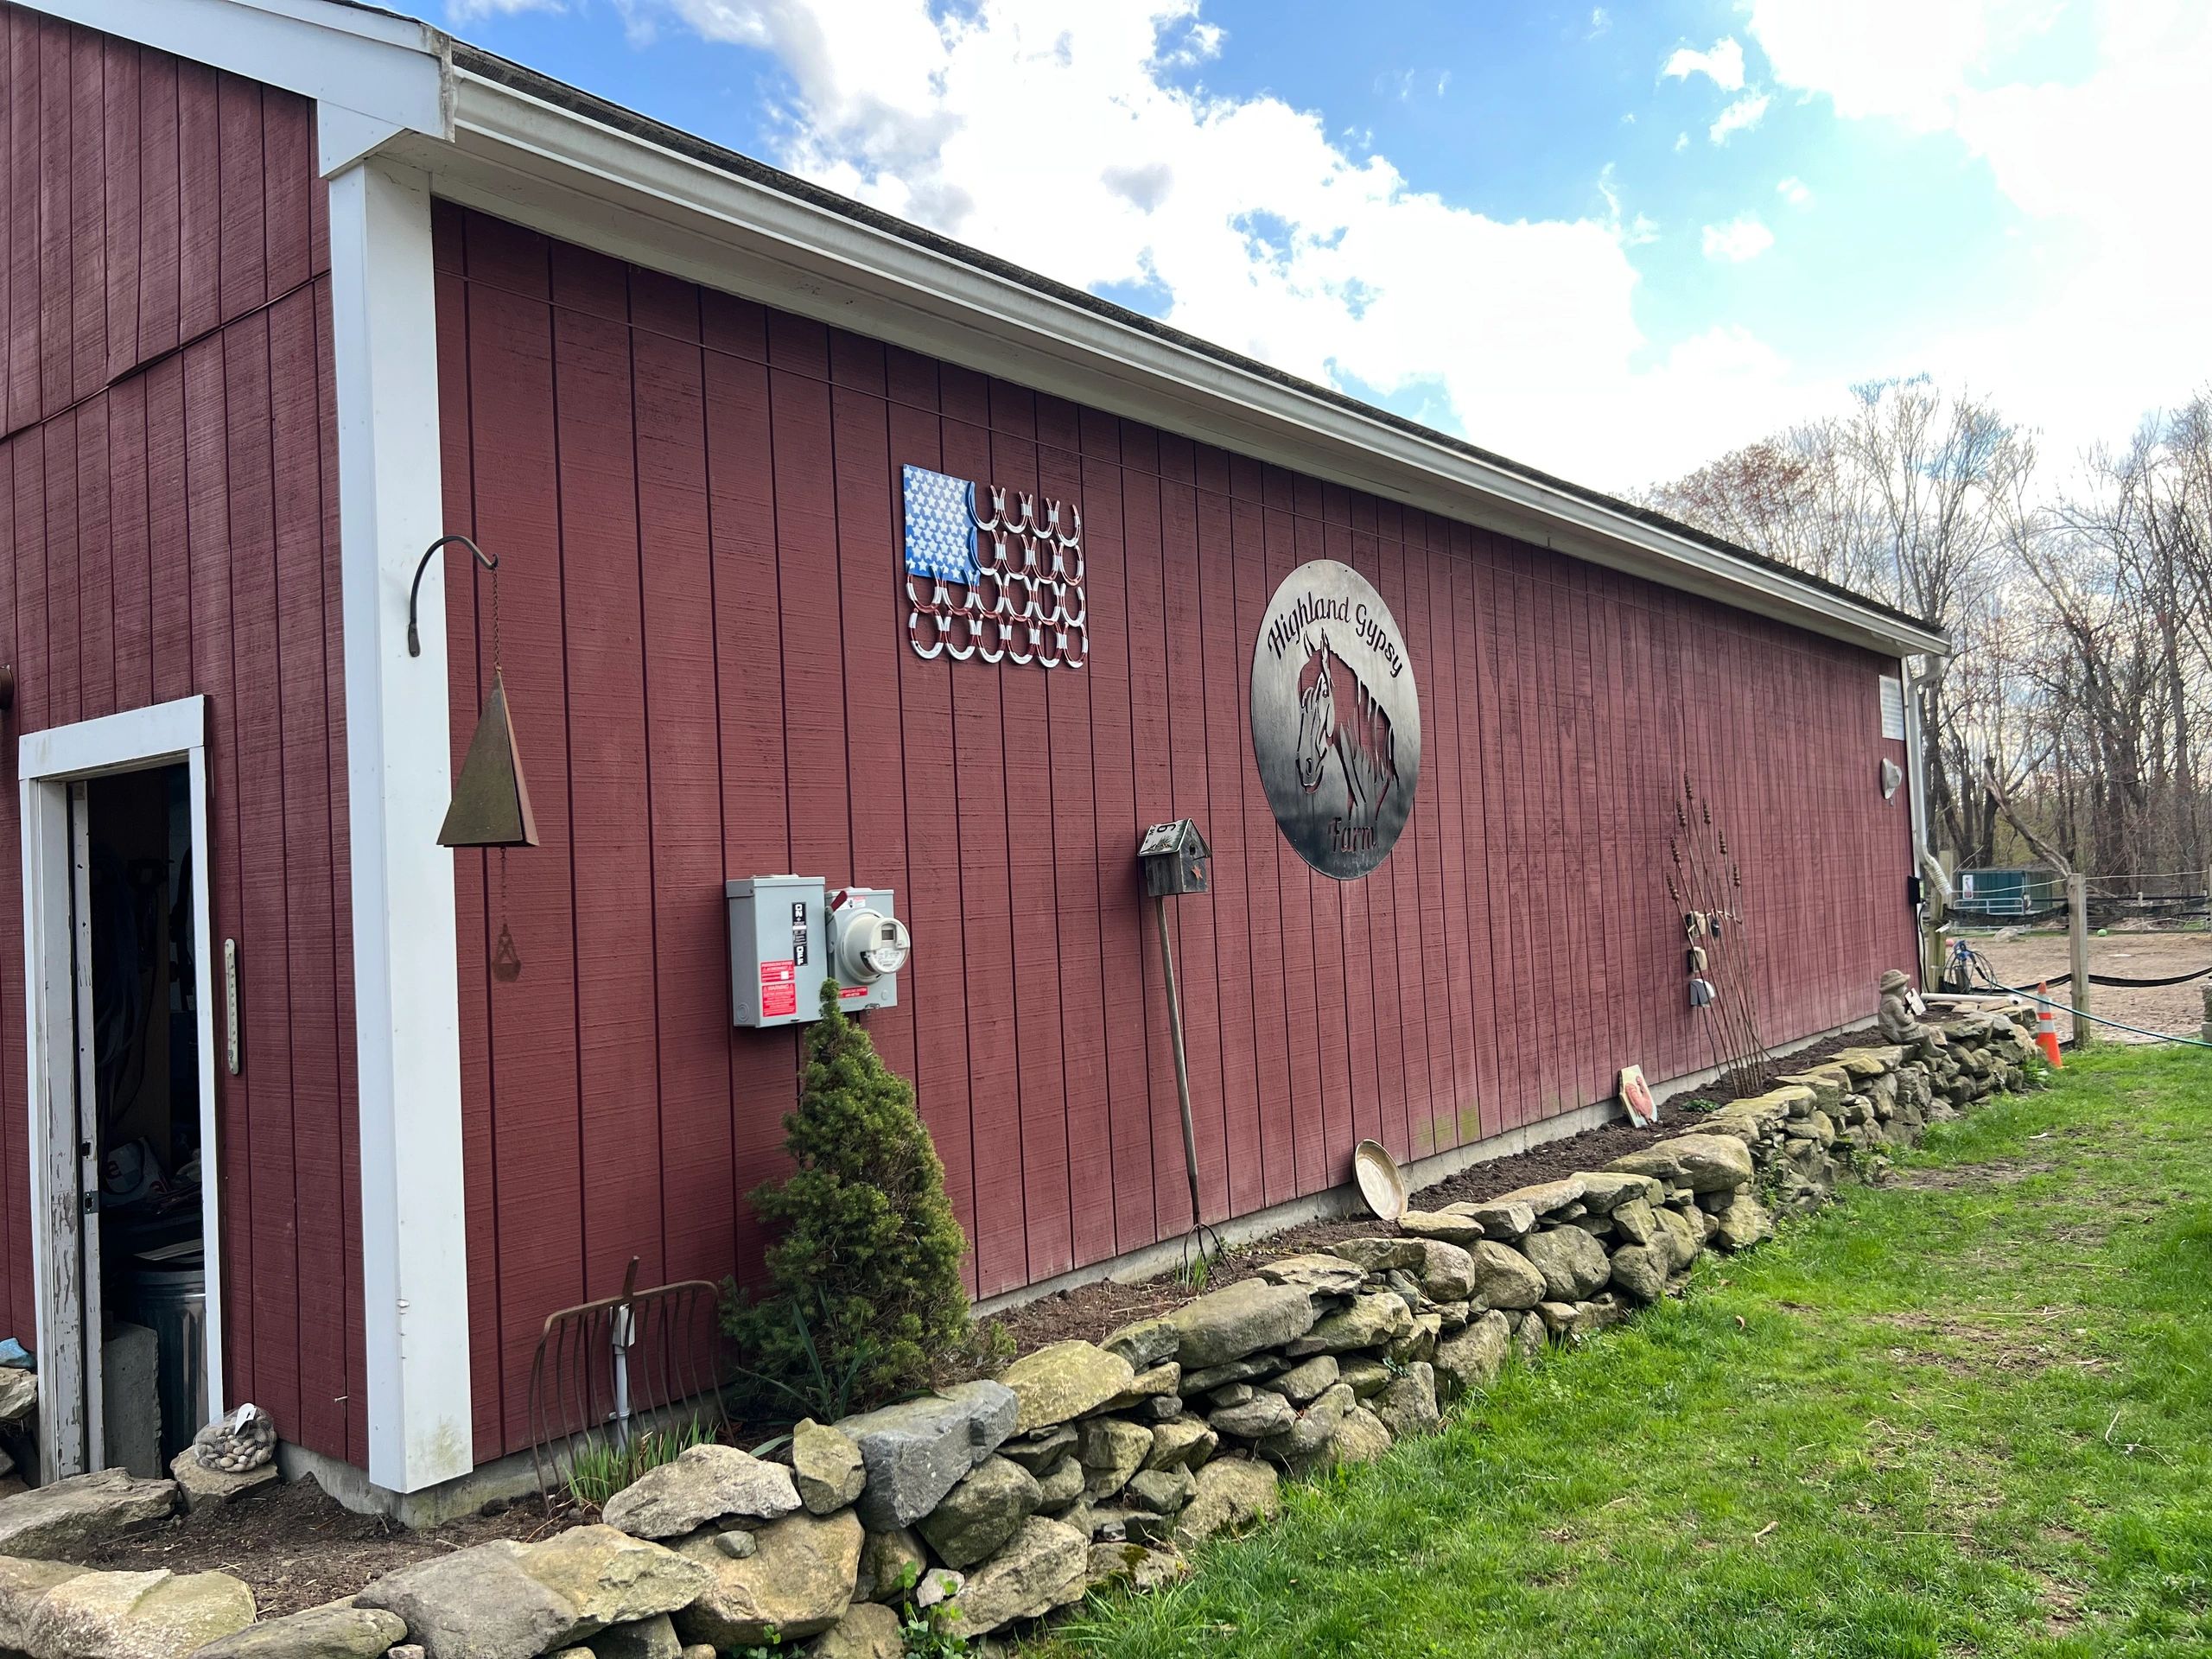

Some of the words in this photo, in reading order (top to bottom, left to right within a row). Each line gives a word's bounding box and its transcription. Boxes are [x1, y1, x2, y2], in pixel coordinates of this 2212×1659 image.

[1268, 591, 1351, 660] Highland
[1356, 604, 1402, 677] Gypsy
[1327, 817, 1376, 852] Farm
[795, 904, 803, 917] ON
